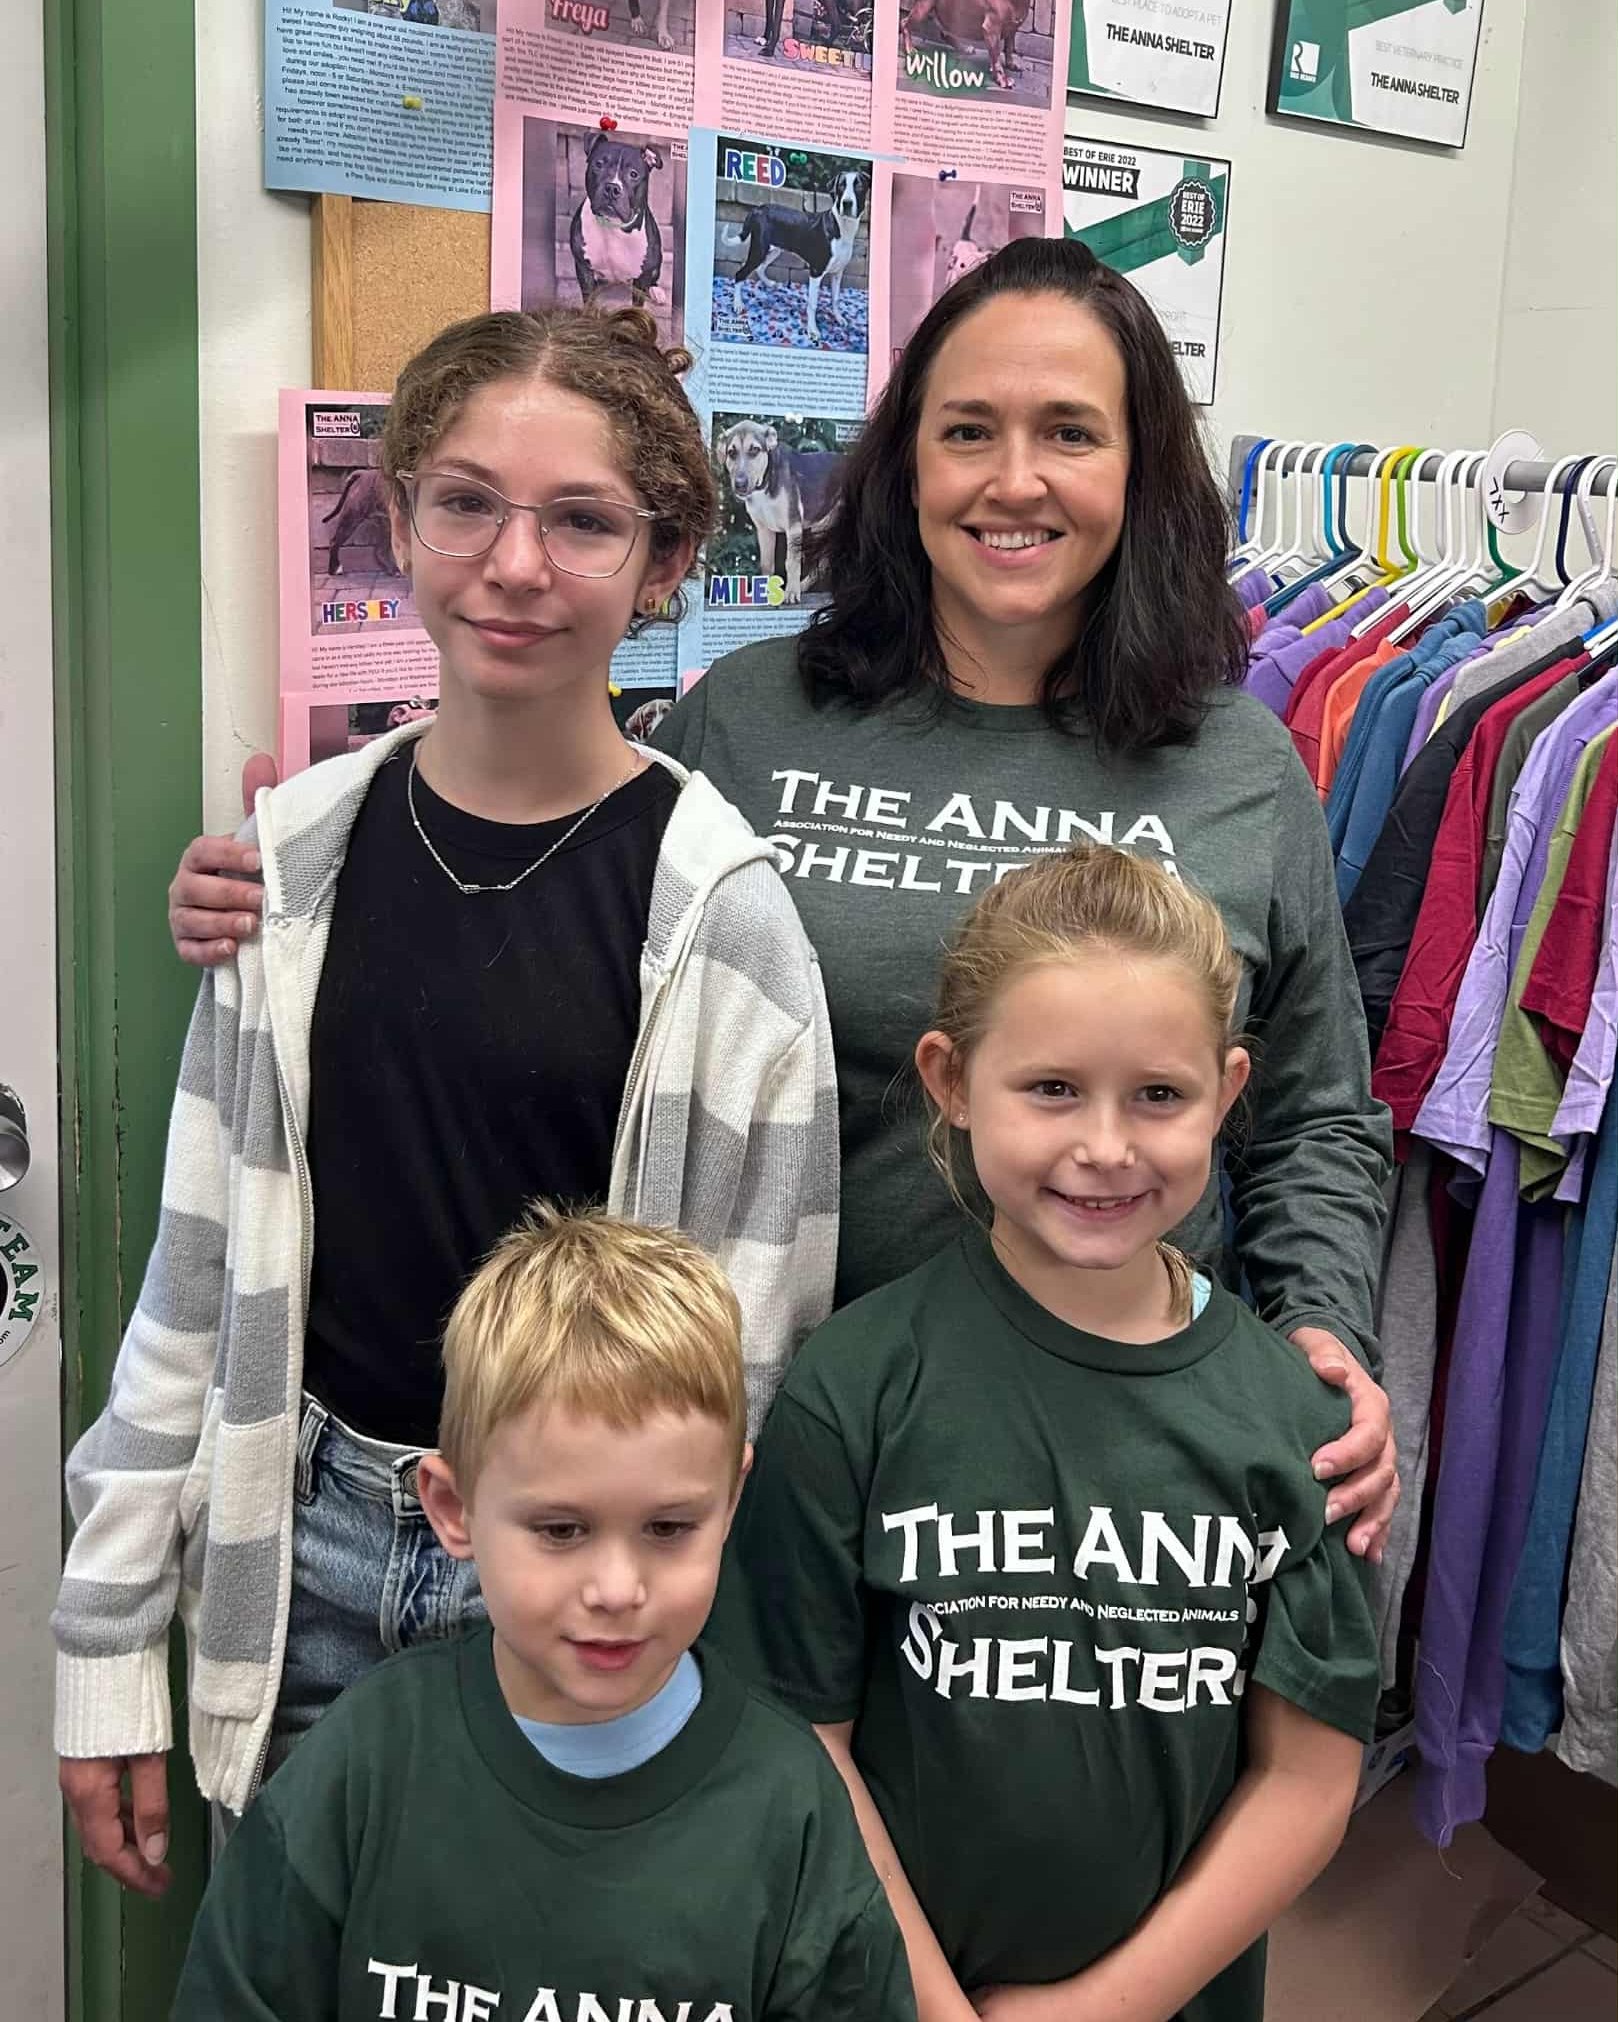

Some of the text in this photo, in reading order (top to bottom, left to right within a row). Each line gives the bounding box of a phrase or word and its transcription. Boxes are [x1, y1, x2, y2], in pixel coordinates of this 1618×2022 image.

[1106, 23, 1215, 60] THE ANNA SHELTER
[907, 51, 984, 88] Willow
[1371, 72, 1460, 104] THE ANNA SHELTER
[726, 149, 786, 187] REED
[1064, 146, 1136, 166] BEST OF ERIE 2022
[1063, 164, 1133, 193] WINNER
[1180, 214, 1204, 227] 2022
[1182, 200, 1204, 214] ERIE
[1170, 341, 1205, 357] ELTER
[710, 576, 784, 606] MILES
[322, 600, 400, 623] HERSEY
[771, 769, 1177, 856] THE ANNA
[773, 819, 848, 833] ASSOCIATION
[850, 828, 874, 838] FOR
[876, 830, 918, 843] NEEDY
[919, 837, 946, 847] AND
[947, 840, 1019, 853] NEGLECTED
[882, 1502, 1056, 1583] THE
[988, 1595, 1019, 1610] FOR
[1021, 1596, 1067, 1610] NEEDY
[1070, 1598, 1094, 1618] AND
[1098, 1604, 1180, 1622] NEGLECTED
[1181, 1608, 1239, 1622] ANIMALS
[901, 1602, 1238, 1714] SHELTER
[368, 1958, 500, 2022] THE
